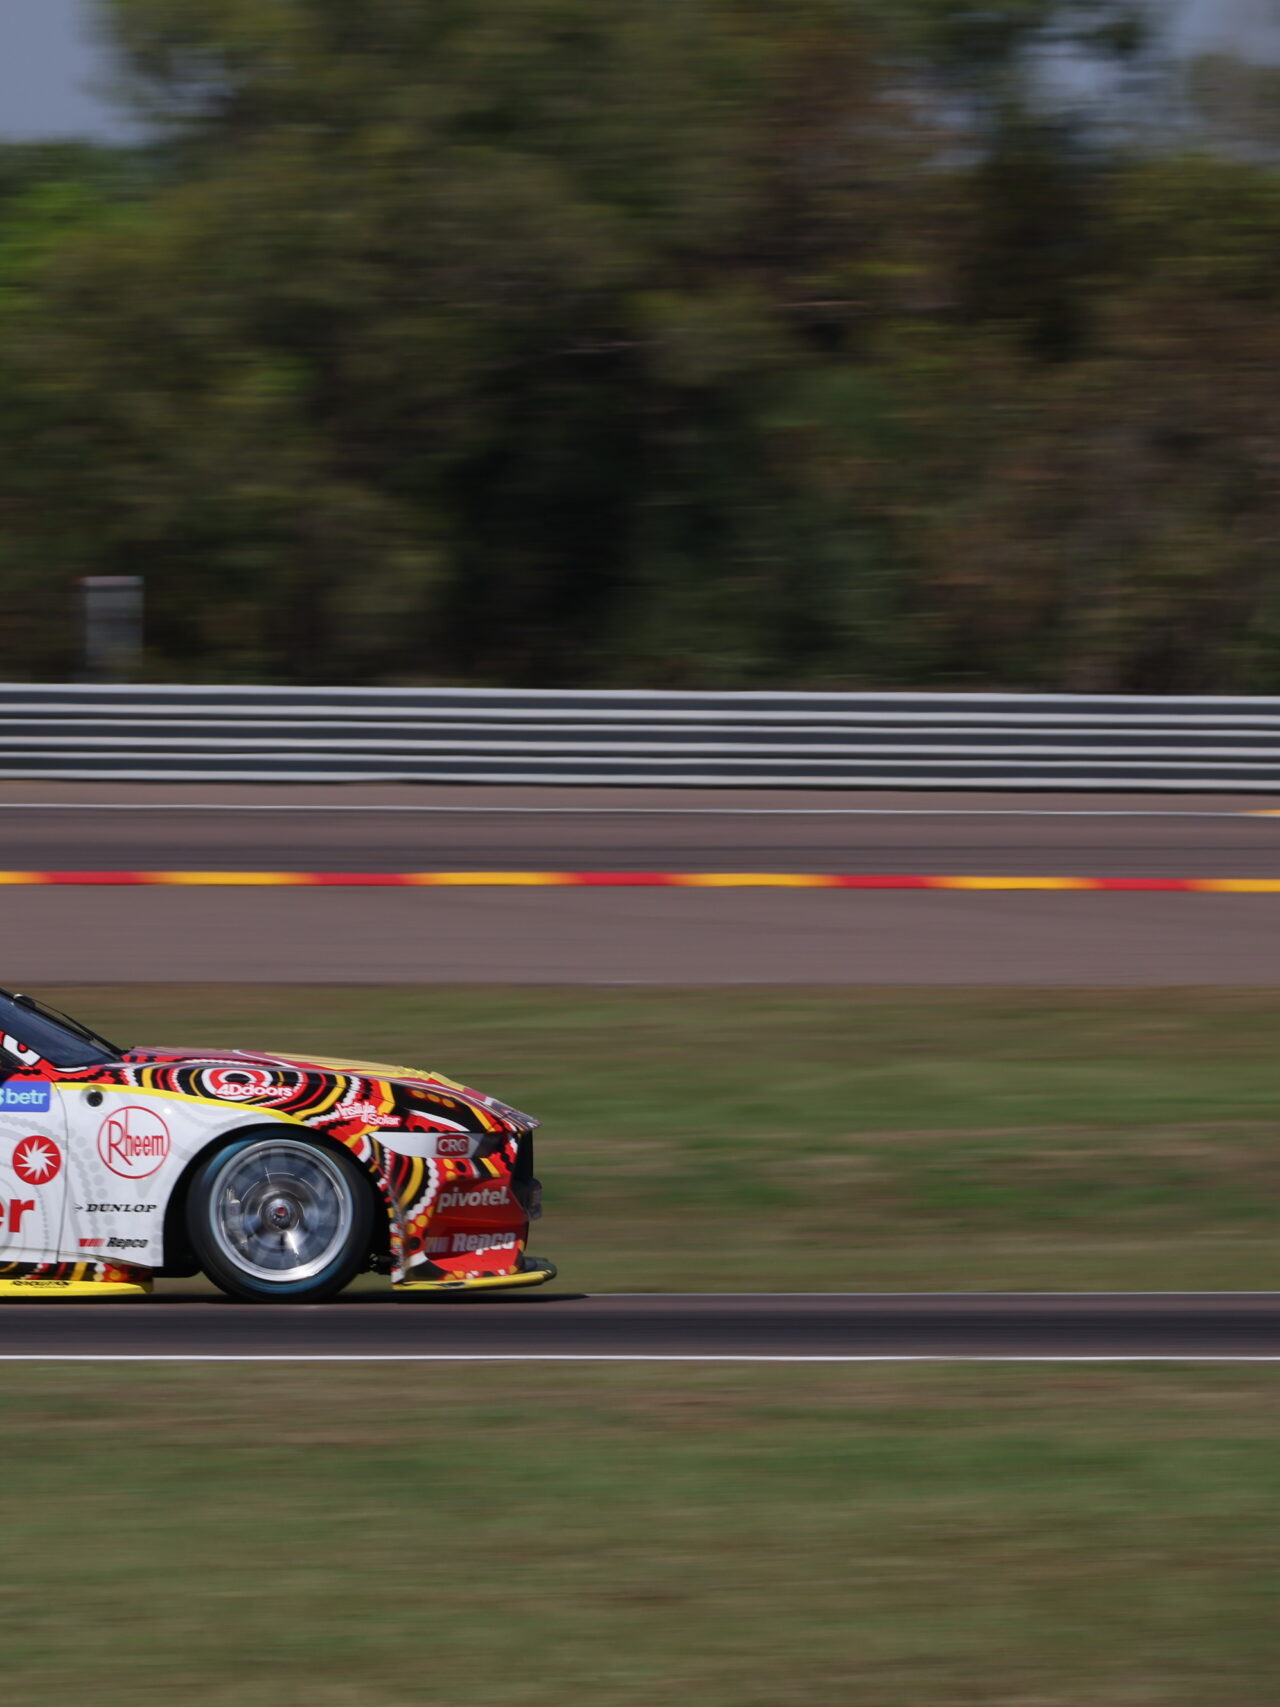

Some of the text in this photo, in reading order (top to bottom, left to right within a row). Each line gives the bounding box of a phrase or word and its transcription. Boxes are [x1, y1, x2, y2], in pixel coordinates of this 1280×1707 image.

[216, 1084, 293, 1097] 4Ddoors
[109, 1109, 166, 1166] Rheem
[439, 1138, 468, 1152] CRC
[86, 1203, 157, 1213] DUNLOP
[107, 1237, 148, 1249] Repco
[452, 1232, 516, 1255] Repco
